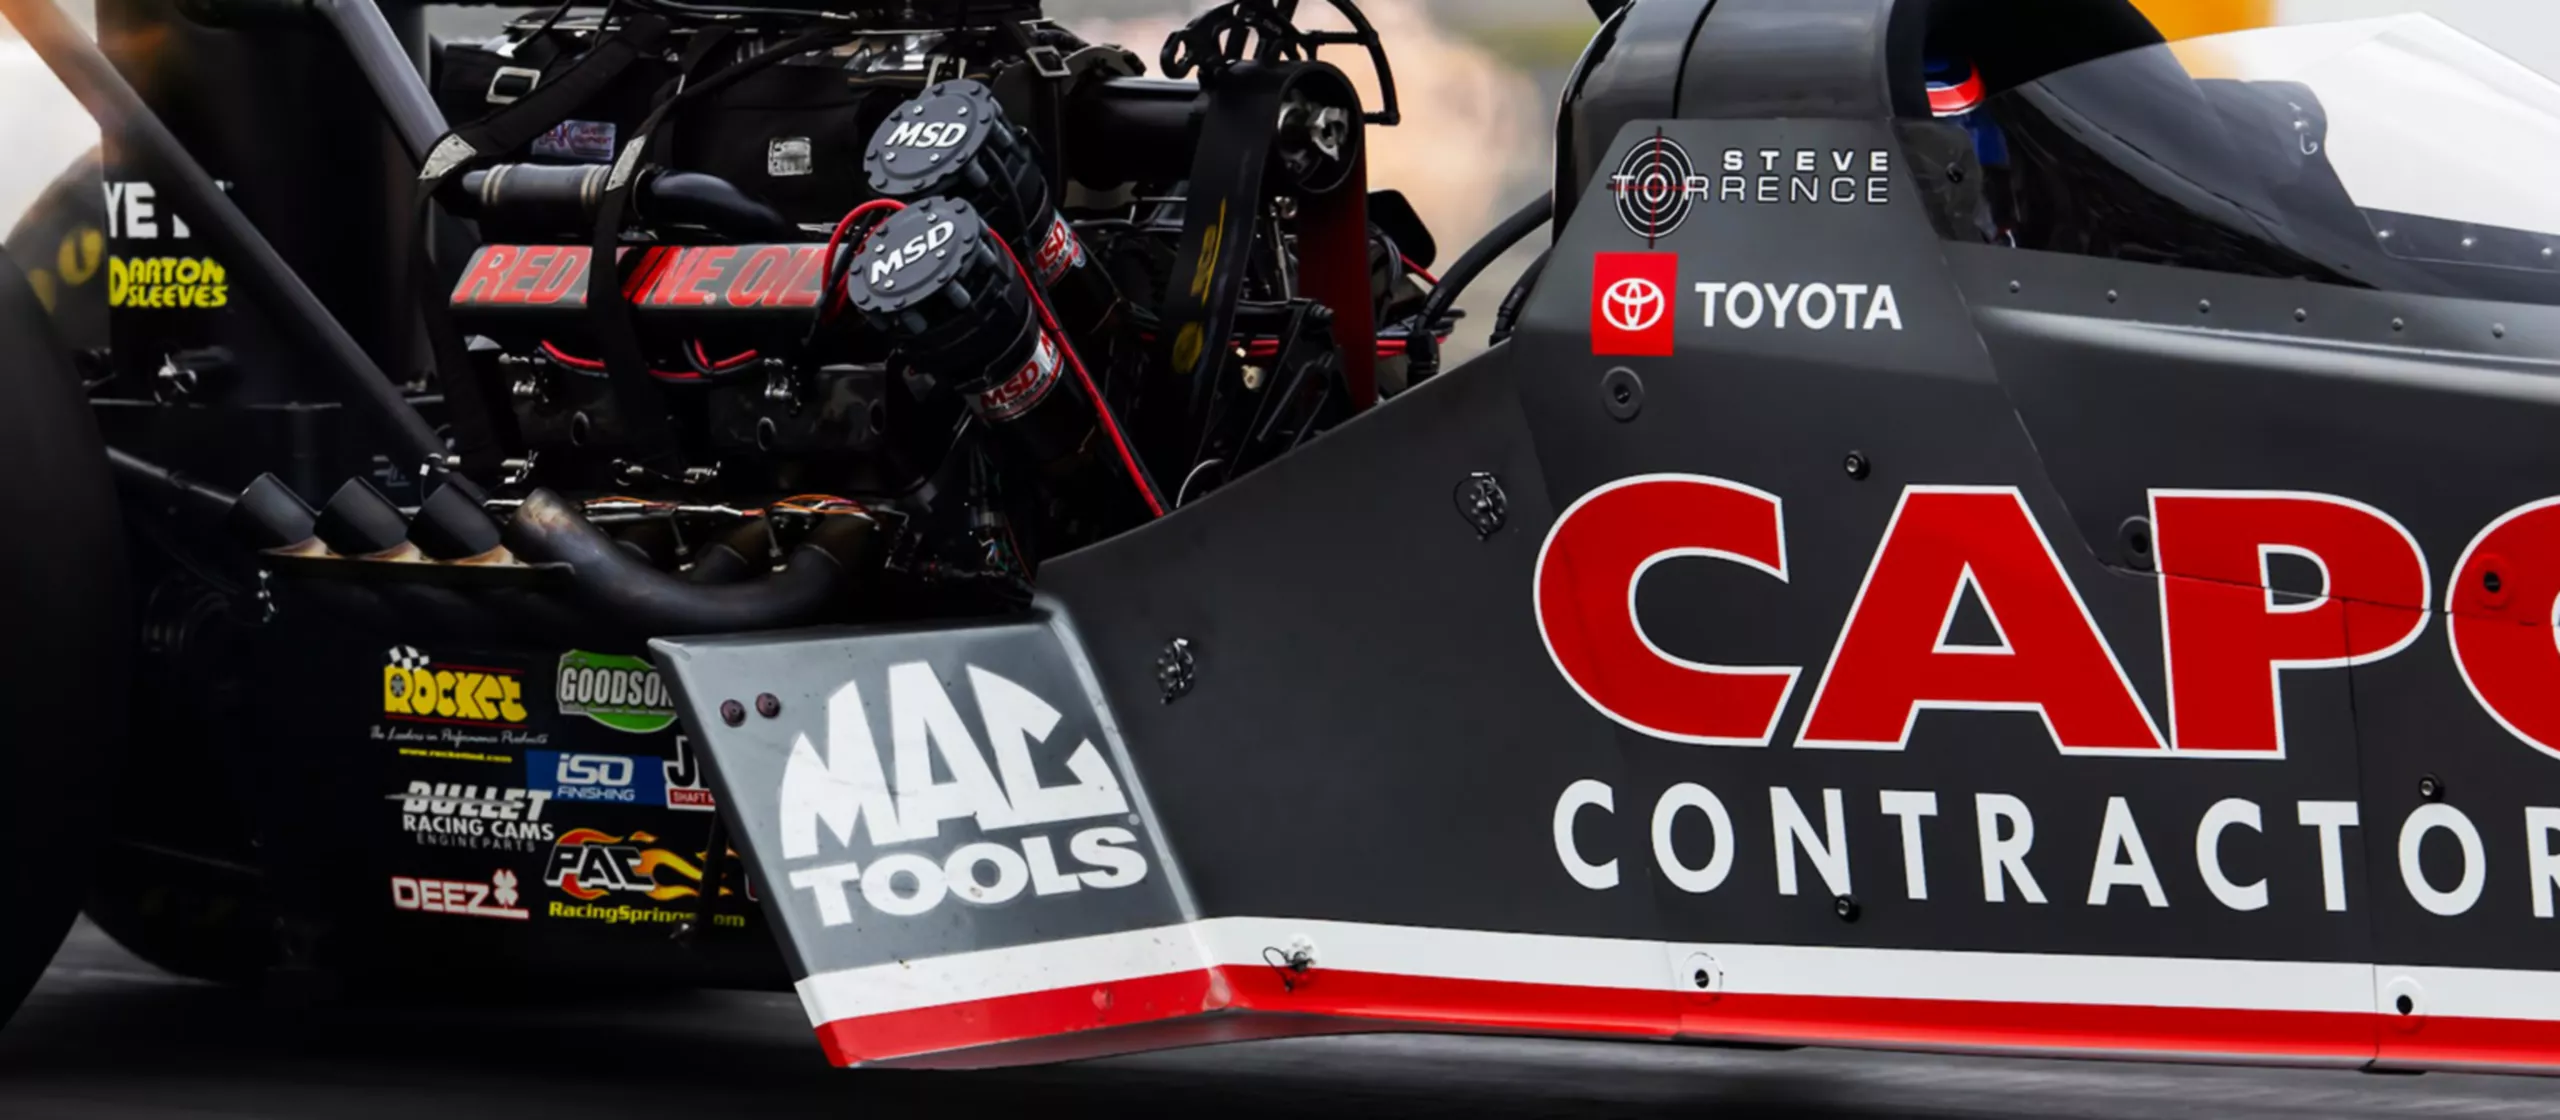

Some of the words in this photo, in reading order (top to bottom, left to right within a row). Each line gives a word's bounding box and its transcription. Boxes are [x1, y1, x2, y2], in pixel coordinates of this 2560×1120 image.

[885, 121, 967, 148] MSD
[1723, 150, 1889, 171] STEVE
[1612, 174, 1889, 203] TORRENCE
[869, 220, 955, 284] MSD
[451, 245, 593, 304] RED
[726, 246, 829, 308] OIL
[127, 284, 229, 308] SLEEVES
[1695, 280, 1903, 330] TOYOTA
[978, 360, 1041, 409] MSD
[501, 730, 549, 744] Products
[779, 660, 1131, 860] MAC
[403, 780, 553, 821] BULLET
[557, 785, 635, 803] FINISHING
[673, 789, 706, 803] SHAFT
[403, 814, 484, 837] RACING
[491, 820, 555, 842] CAMS
[416, 832, 478, 849] ENGINE
[482, 837, 536, 853] PARTS
[543, 843, 657, 892] PAC
[788, 826, 1148, 927] TOOLS
[391, 876, 529, 920] DEEZ
